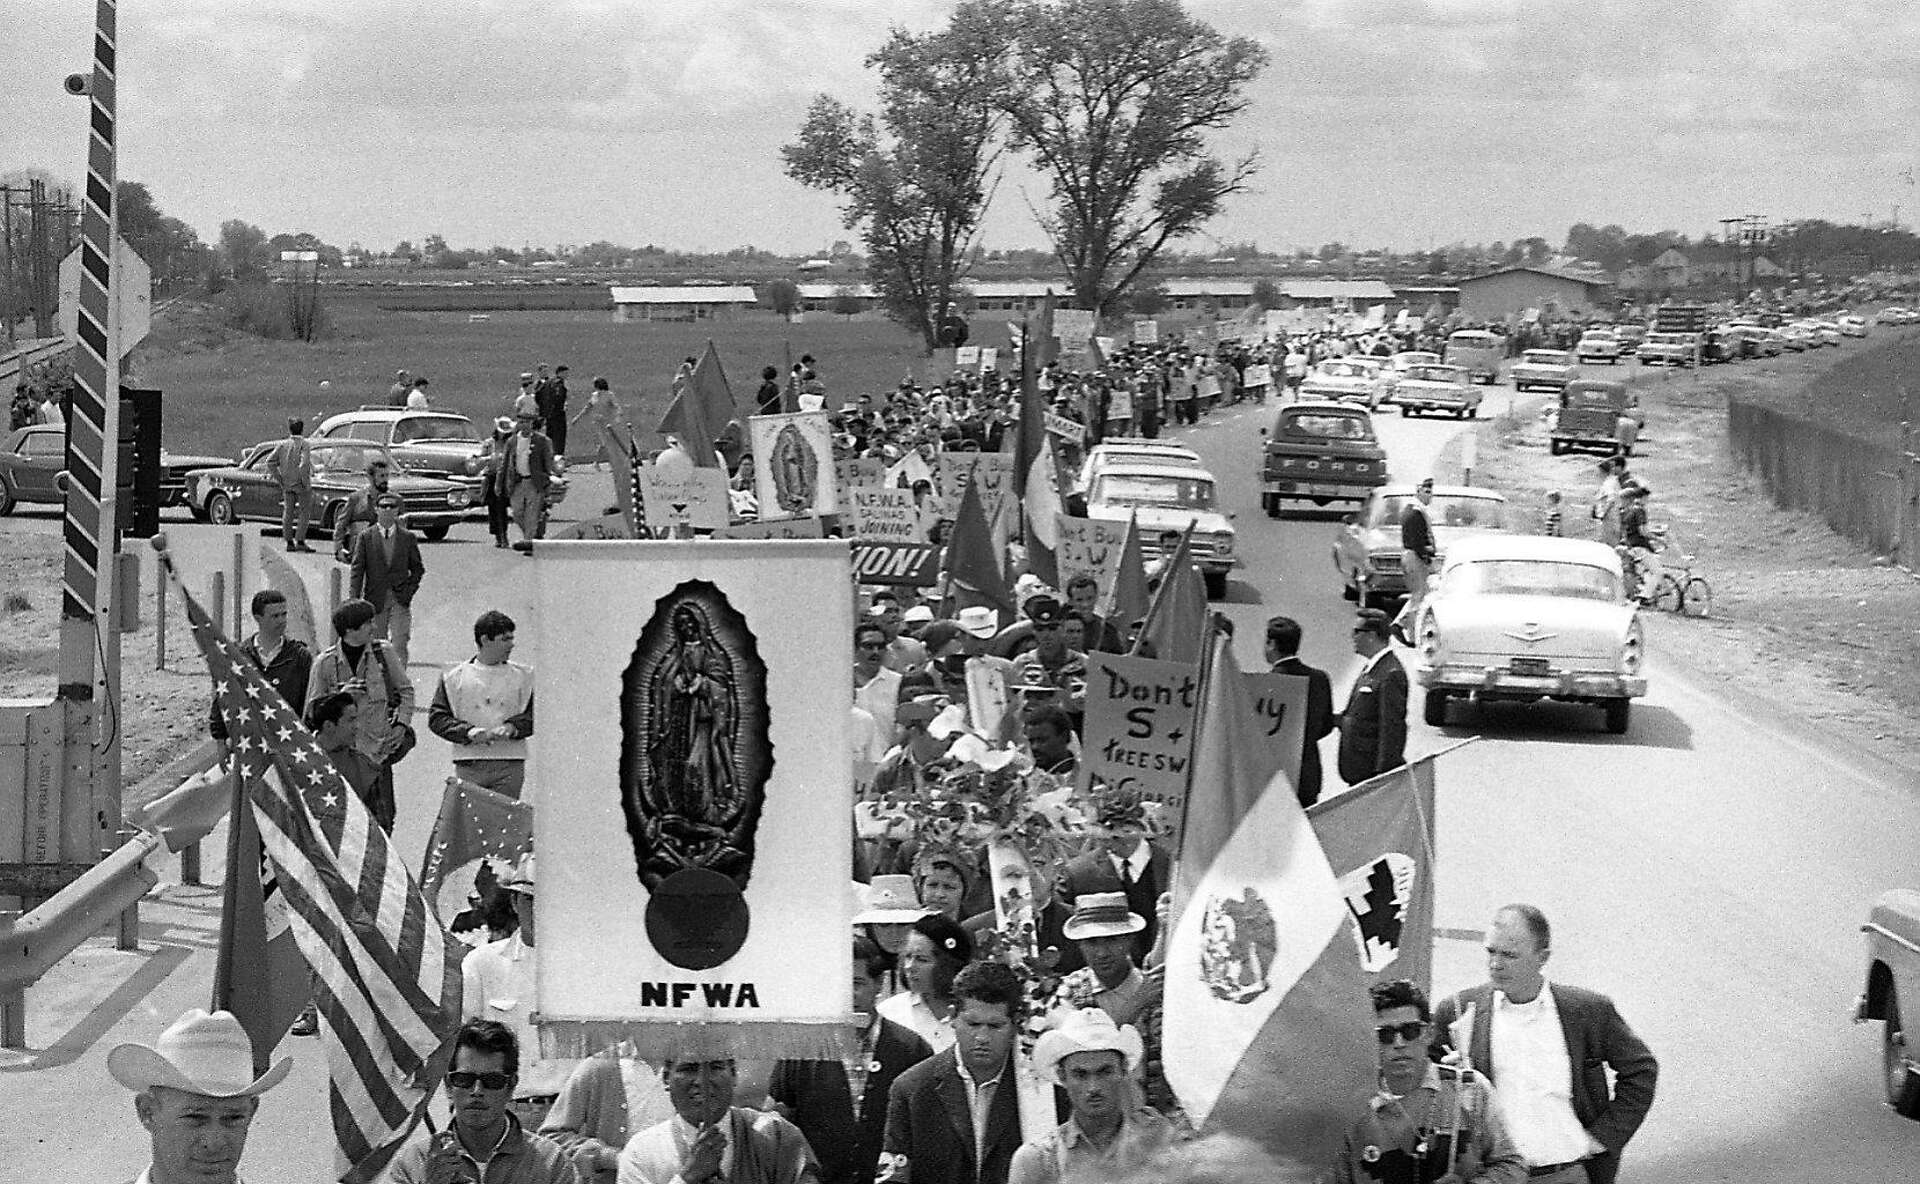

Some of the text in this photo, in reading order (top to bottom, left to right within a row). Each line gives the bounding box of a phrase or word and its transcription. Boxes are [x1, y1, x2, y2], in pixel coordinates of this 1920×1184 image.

[1283, 459, 1369, 472] FORD
[860, 519, 913, 537] JOINING
[1102, 664, 1195, 708] Don't
[1126, 707, 1156, 738] S
[641, 982, 760, 1008] NFWA
